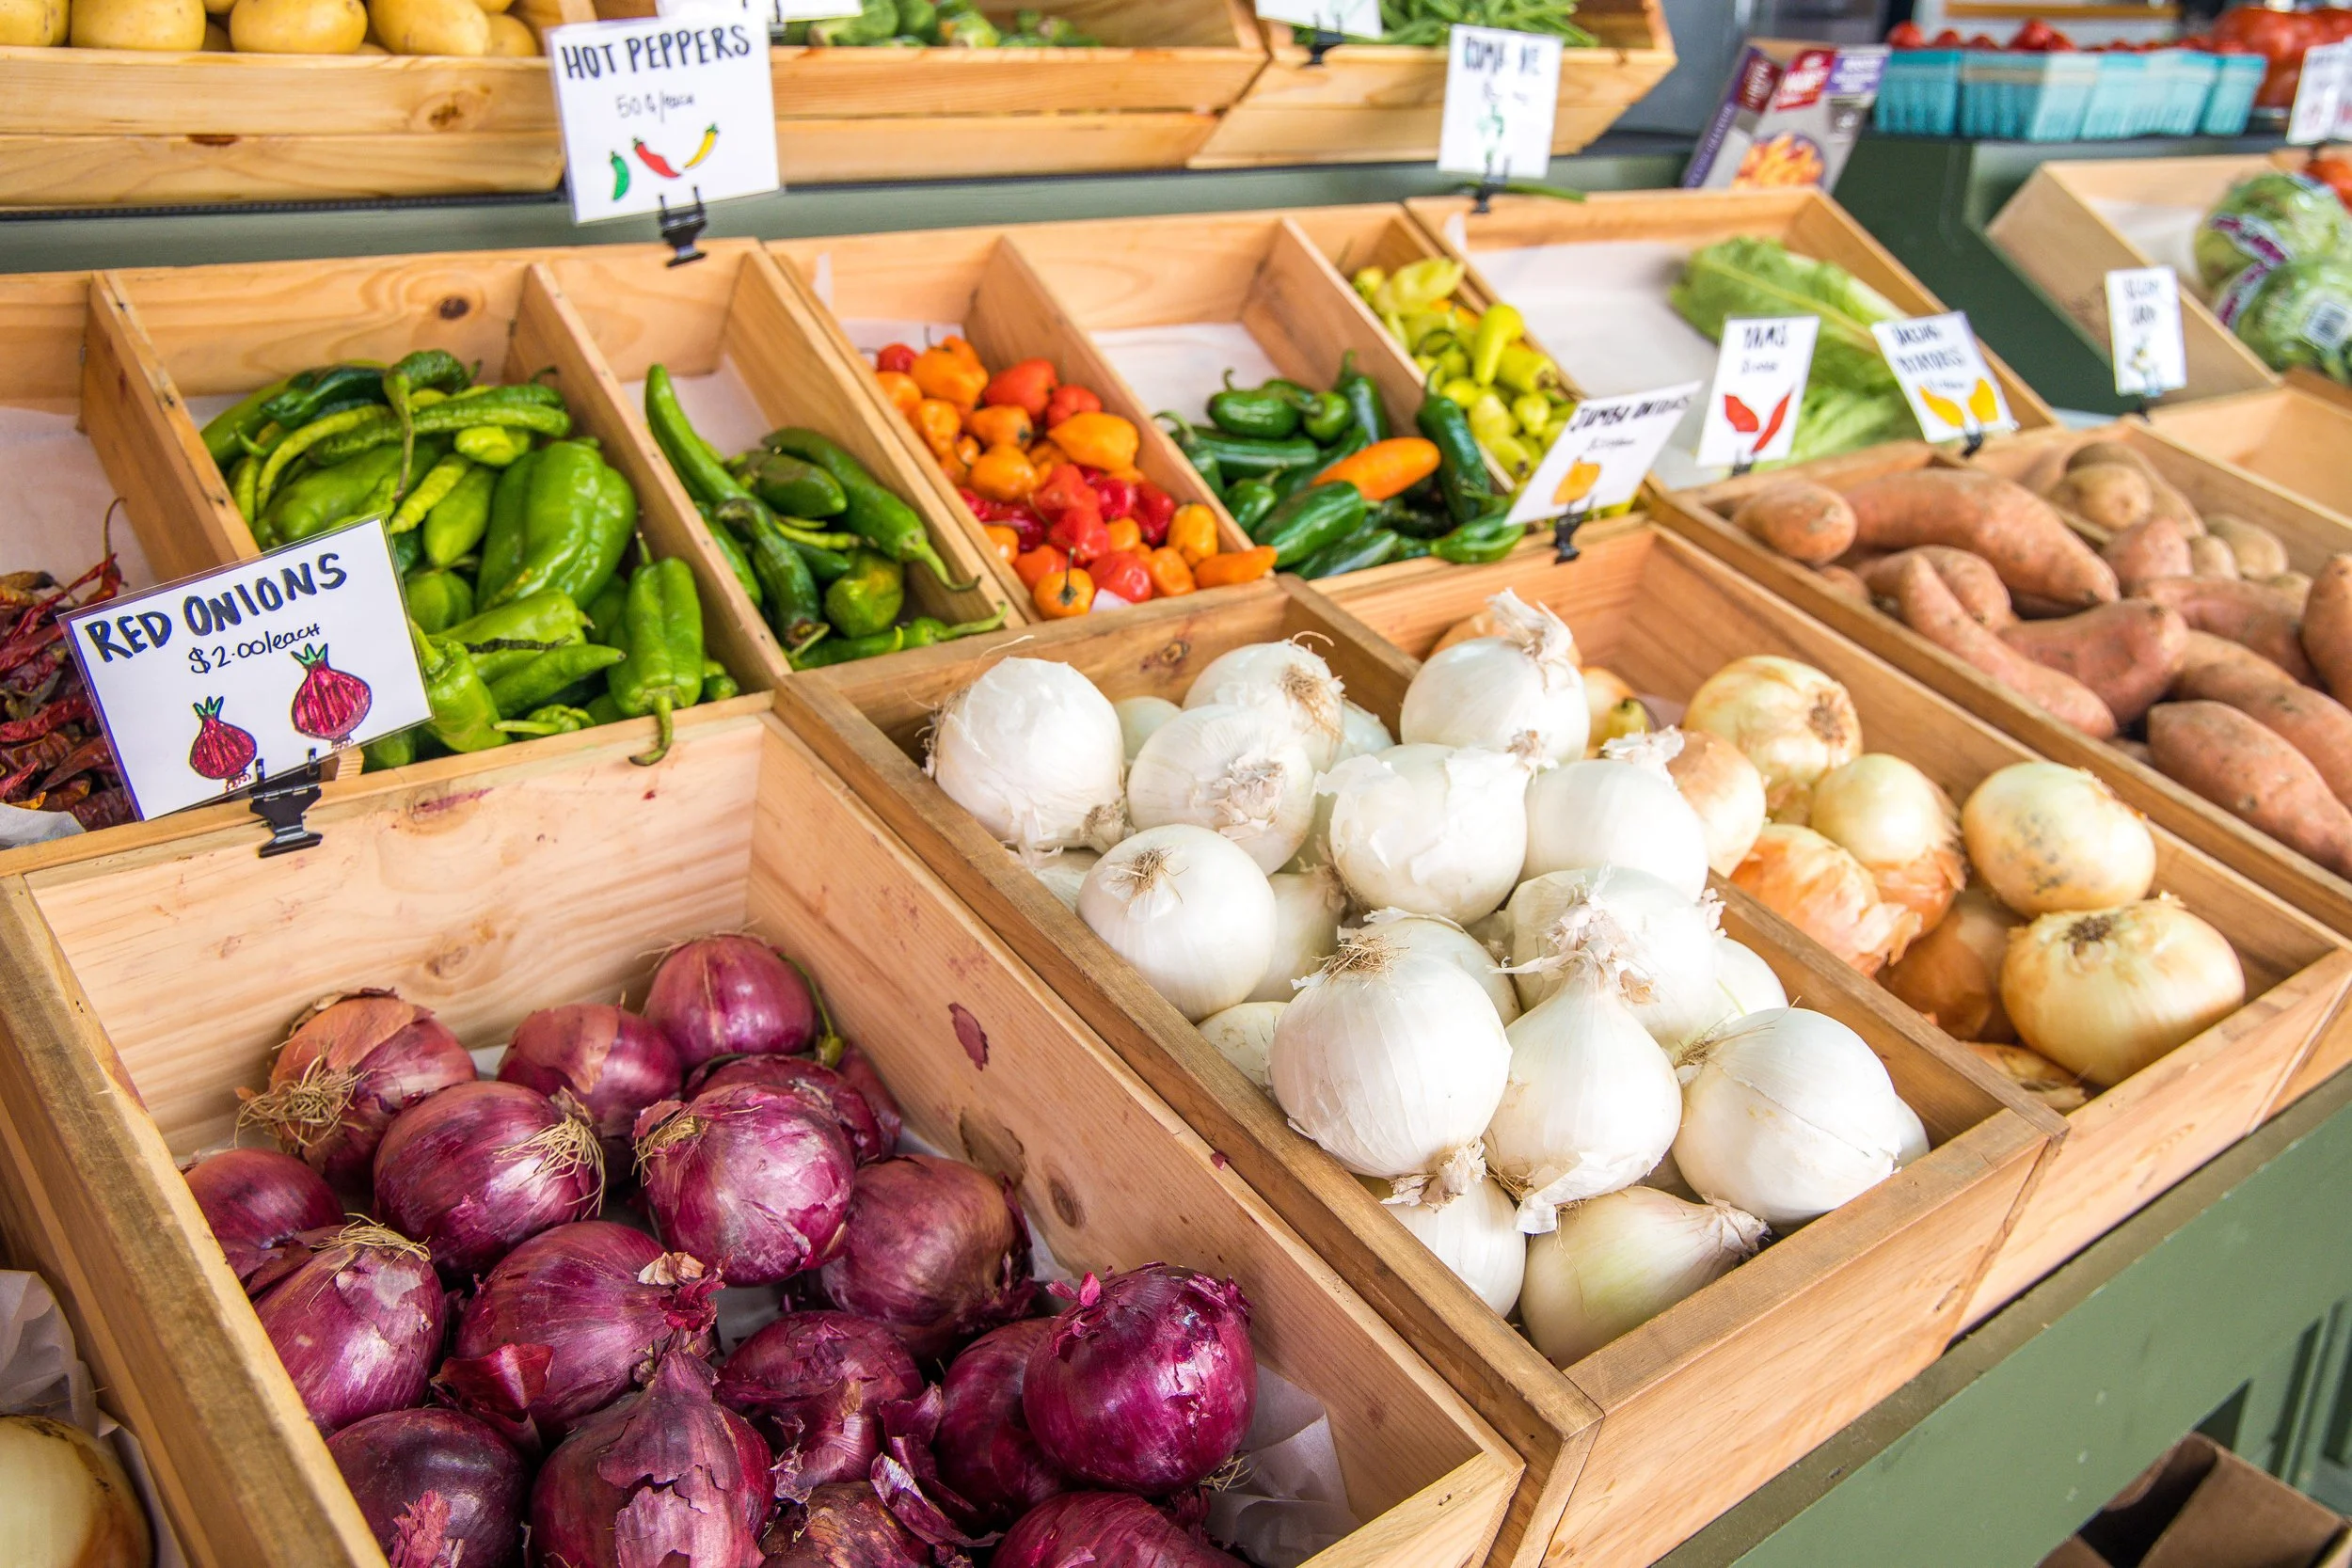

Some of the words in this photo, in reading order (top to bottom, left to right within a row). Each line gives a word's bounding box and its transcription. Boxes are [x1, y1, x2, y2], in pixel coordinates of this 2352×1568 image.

[561, 42, 616, 80] HOT
[625, 24, 751, 73] PEPPERS
[84, 610, 173, 663] RED
[183, 552, 347, 637] ONIONS
